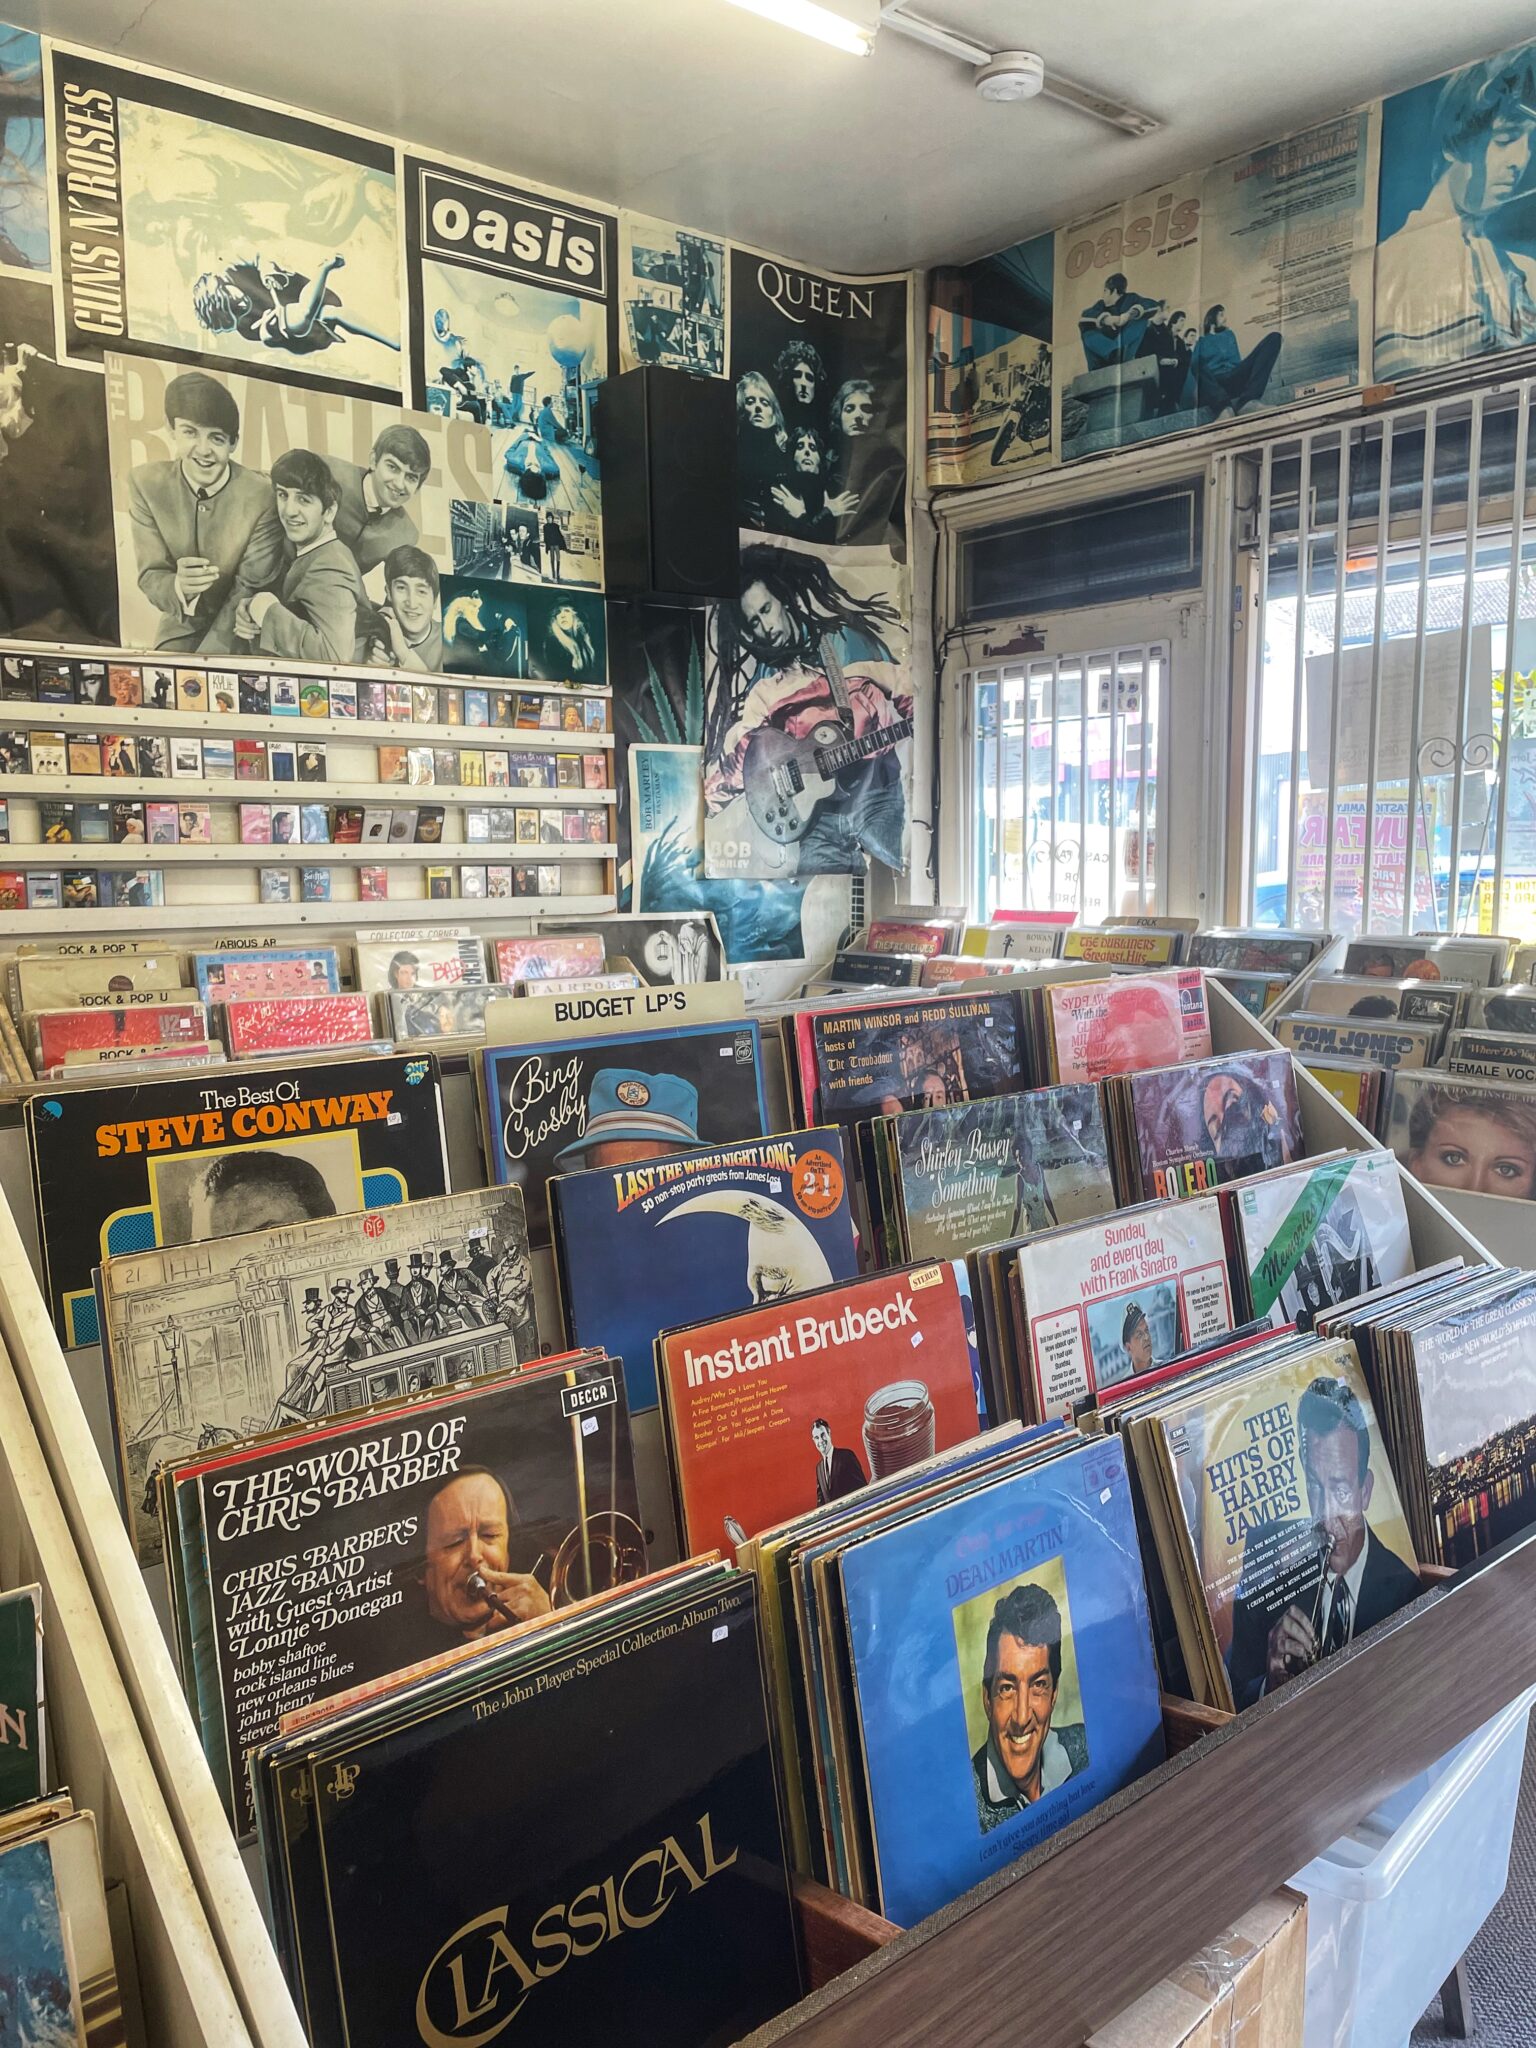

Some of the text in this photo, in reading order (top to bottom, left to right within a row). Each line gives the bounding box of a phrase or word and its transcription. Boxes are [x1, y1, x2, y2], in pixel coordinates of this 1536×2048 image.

[431, 198, 596, 277] oasis
[1065, 193, 1200, 279] oasis
[72, 242, 126, 337] GUNS
[757, 262, 874, 322] QUEEN
[109, 356, 124, 420] THE
[114, 352, 494, 556] BATLES
[213, 674, 234, 691] KYLIE
[511, 752, 552, 763] SHALAMA
[641, 758, 651, 803] MARLEY
[709, 840, 752, 858] BOB
[427, 928, 460, 939] CORNER
[1079, 937, 1155, 950] THE DUBLINERS
[1137, 918, 1157, 926] FOLK
[430, 957, 468, 984] BAD
[1082, 950, 1147, 963] Greatest Hits
[79, 992, 168, 1006] ROCK & POP U
[530, 979, 629, 995] FAIRPORT
[555, 991, 687, 1022] BUDGET LP'S
[1062, 997, 1081, 1009] SYD
[824, 1003, 991, 1035] MARTIN WINSOR and REDD SULLIVAN
[1072, 1008, 1107, 1021] With the
[824, 1039, 856, 1053] hosts of
[1292, 1024, 1414, 1054] TOM JONES
[1468, 1043, 1500, 1055] Where
[1501, 1045, 1516, 1057] Do
[403, 1060, 429, 1075] ONE
[827, 1052, 893, 1072] The Troubadour
[829, 1075, 874, 1090] with friends
[1449, 1062, 1536, 1080] FEMALE VOC
[200, 1081, 301, 1112] The Best Of
[509, 1056, 584, 1112] Bing
[95, 1091, 394, 1158] STEVE CONWAY
[503, 1086, 588, 1160] Crosby
[915, 1128, 1010, 1178] Shirley Bassey
[613, 1142, 797, 1213] LAST THE WHOLE NIGHT LONG
[641, 1170, 781, 1214] 50 non-stop party greats from James Last
[1153, 1158, 1218, 1200] BOLERO
[1090, 1239, 1165, 1272] and every day
[1105, 1223, 1146, 1247] Sunday
[1262, 1205, 1317, 1287] Memories
[911, 1268, 939, 1288] STEREO
[1080, 1254, 1178, 1297] with Frank Sinatra
[683, 1292, 918, 1387] Instant Brubeck
[570, 1384, 609, 1409] DECCA
[1171, 1427, 1185, 1439] EMI
[1243, 1402, 1295, 1445] THE
[212, 1416, 467, 1512] THE WORLD OF
[1206, 1429, 1298, 1494] HITS OF
[217, 1446, 462, 1543] CHRIS BARBER
[1218, 1457, 1299, 1516] HARRY
[1225, 1485, 1302, 1546] JAMES
[222, 1516, 418, 1596] CHRIS BARBER'S
[945, 1556, 997, 1598] DEAN
[998, 1525, 1064, 1573] MARTIN
[226, 1554, 365, 1622] JAZZ BAND
[228, 1569, 393, 1640] with Guest Artist
[228, 1589, 404, 1660] Lonnie Donegan
[233, 1640, 327, 1684] bobby shaftoe
[472, 1595, 742, 1722] The John Player Special Collection. Album Two.
[414, 1811, 739, 2048] CLASSICAL
